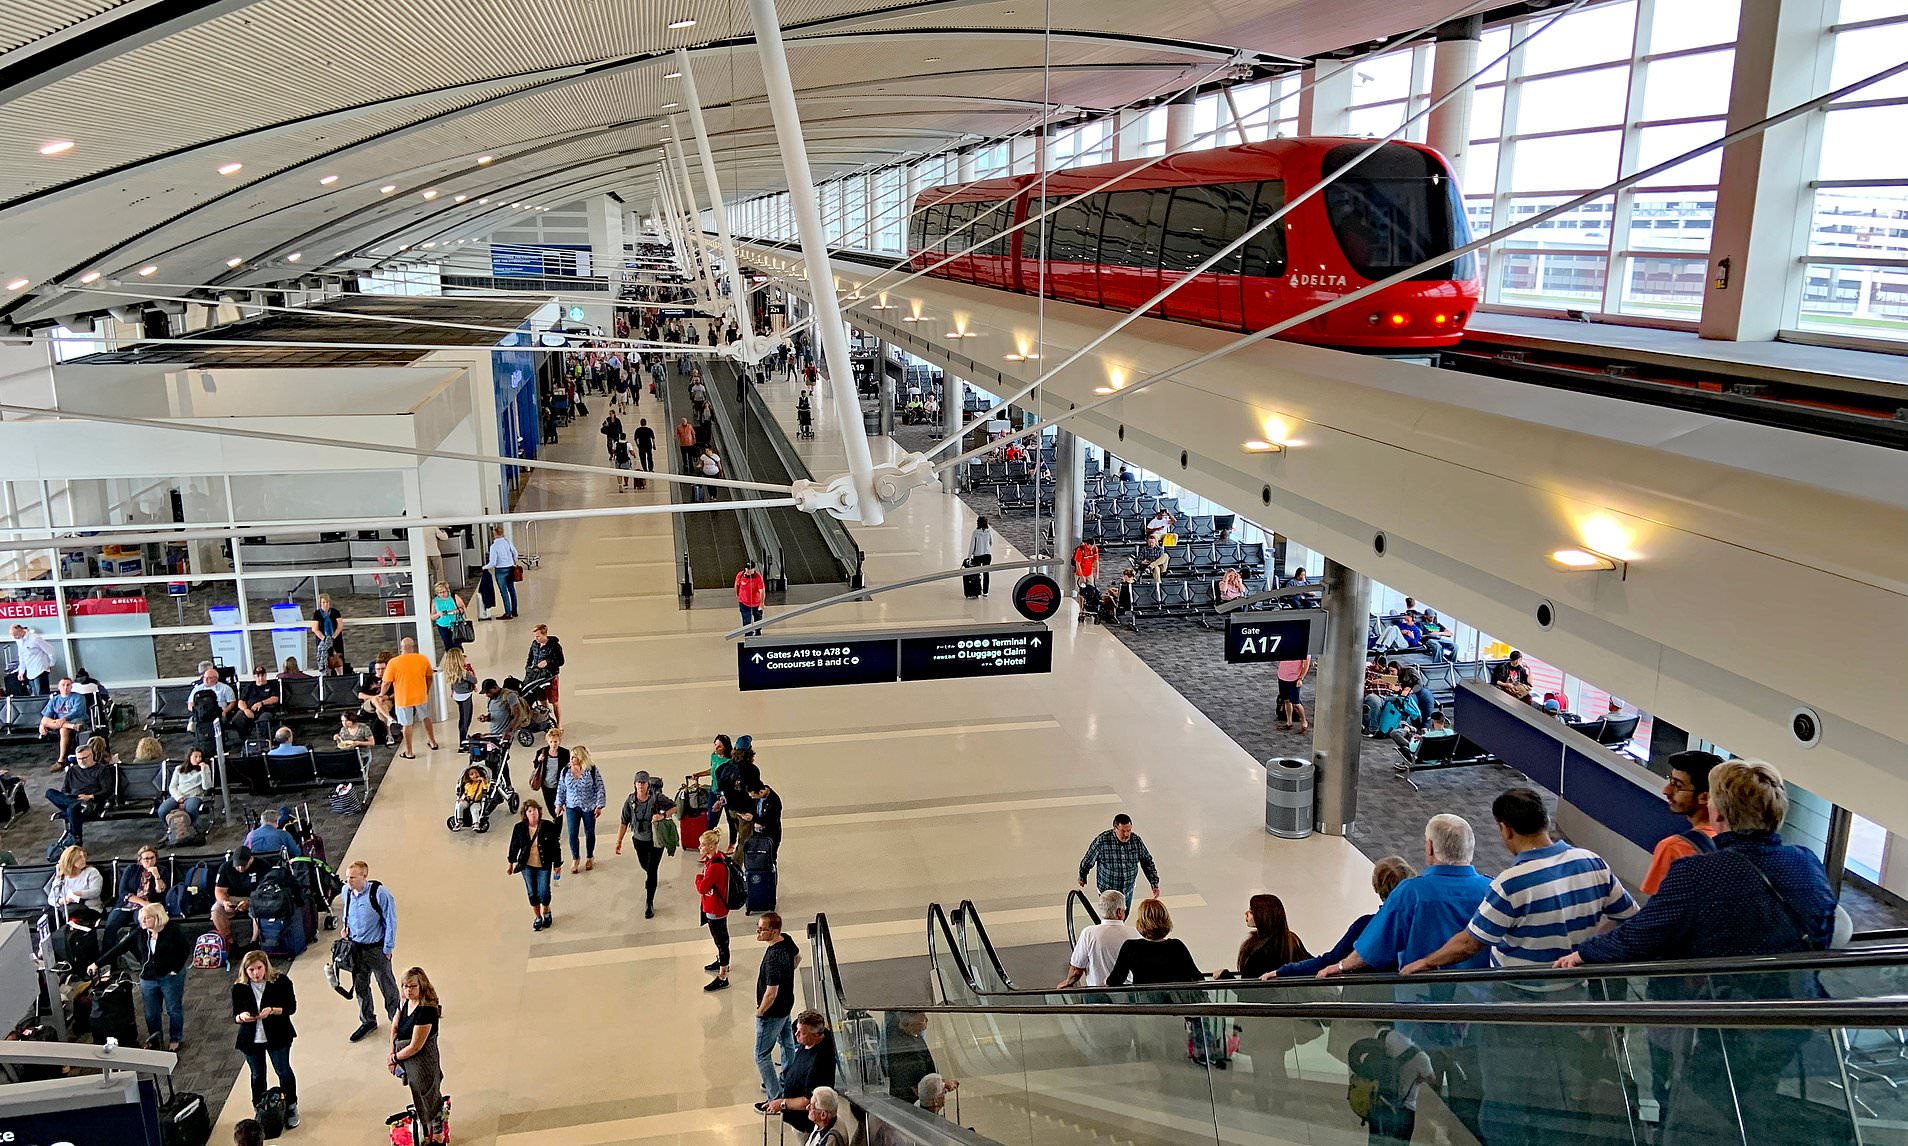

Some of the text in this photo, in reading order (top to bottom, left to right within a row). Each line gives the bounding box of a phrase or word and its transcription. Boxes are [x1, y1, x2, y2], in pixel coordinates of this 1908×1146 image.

[1301, 274, 1347, 286] DELTA
[38, 603, 80, 616] HEP?
[1241, 627, 1260, 635] Gate
[992, 637, 1027, 647] Terminal
[1240, 635, 1282, 654] A17
[766, 648, 841, 659] Gates A19 to A78
[966, 650, 1002, 660] Luggage
[1003, 647, 1027, 656] Claim
[766, 657, 850, 670] Concourses B and C
[1003, 656, 1026, 666] Hotel
